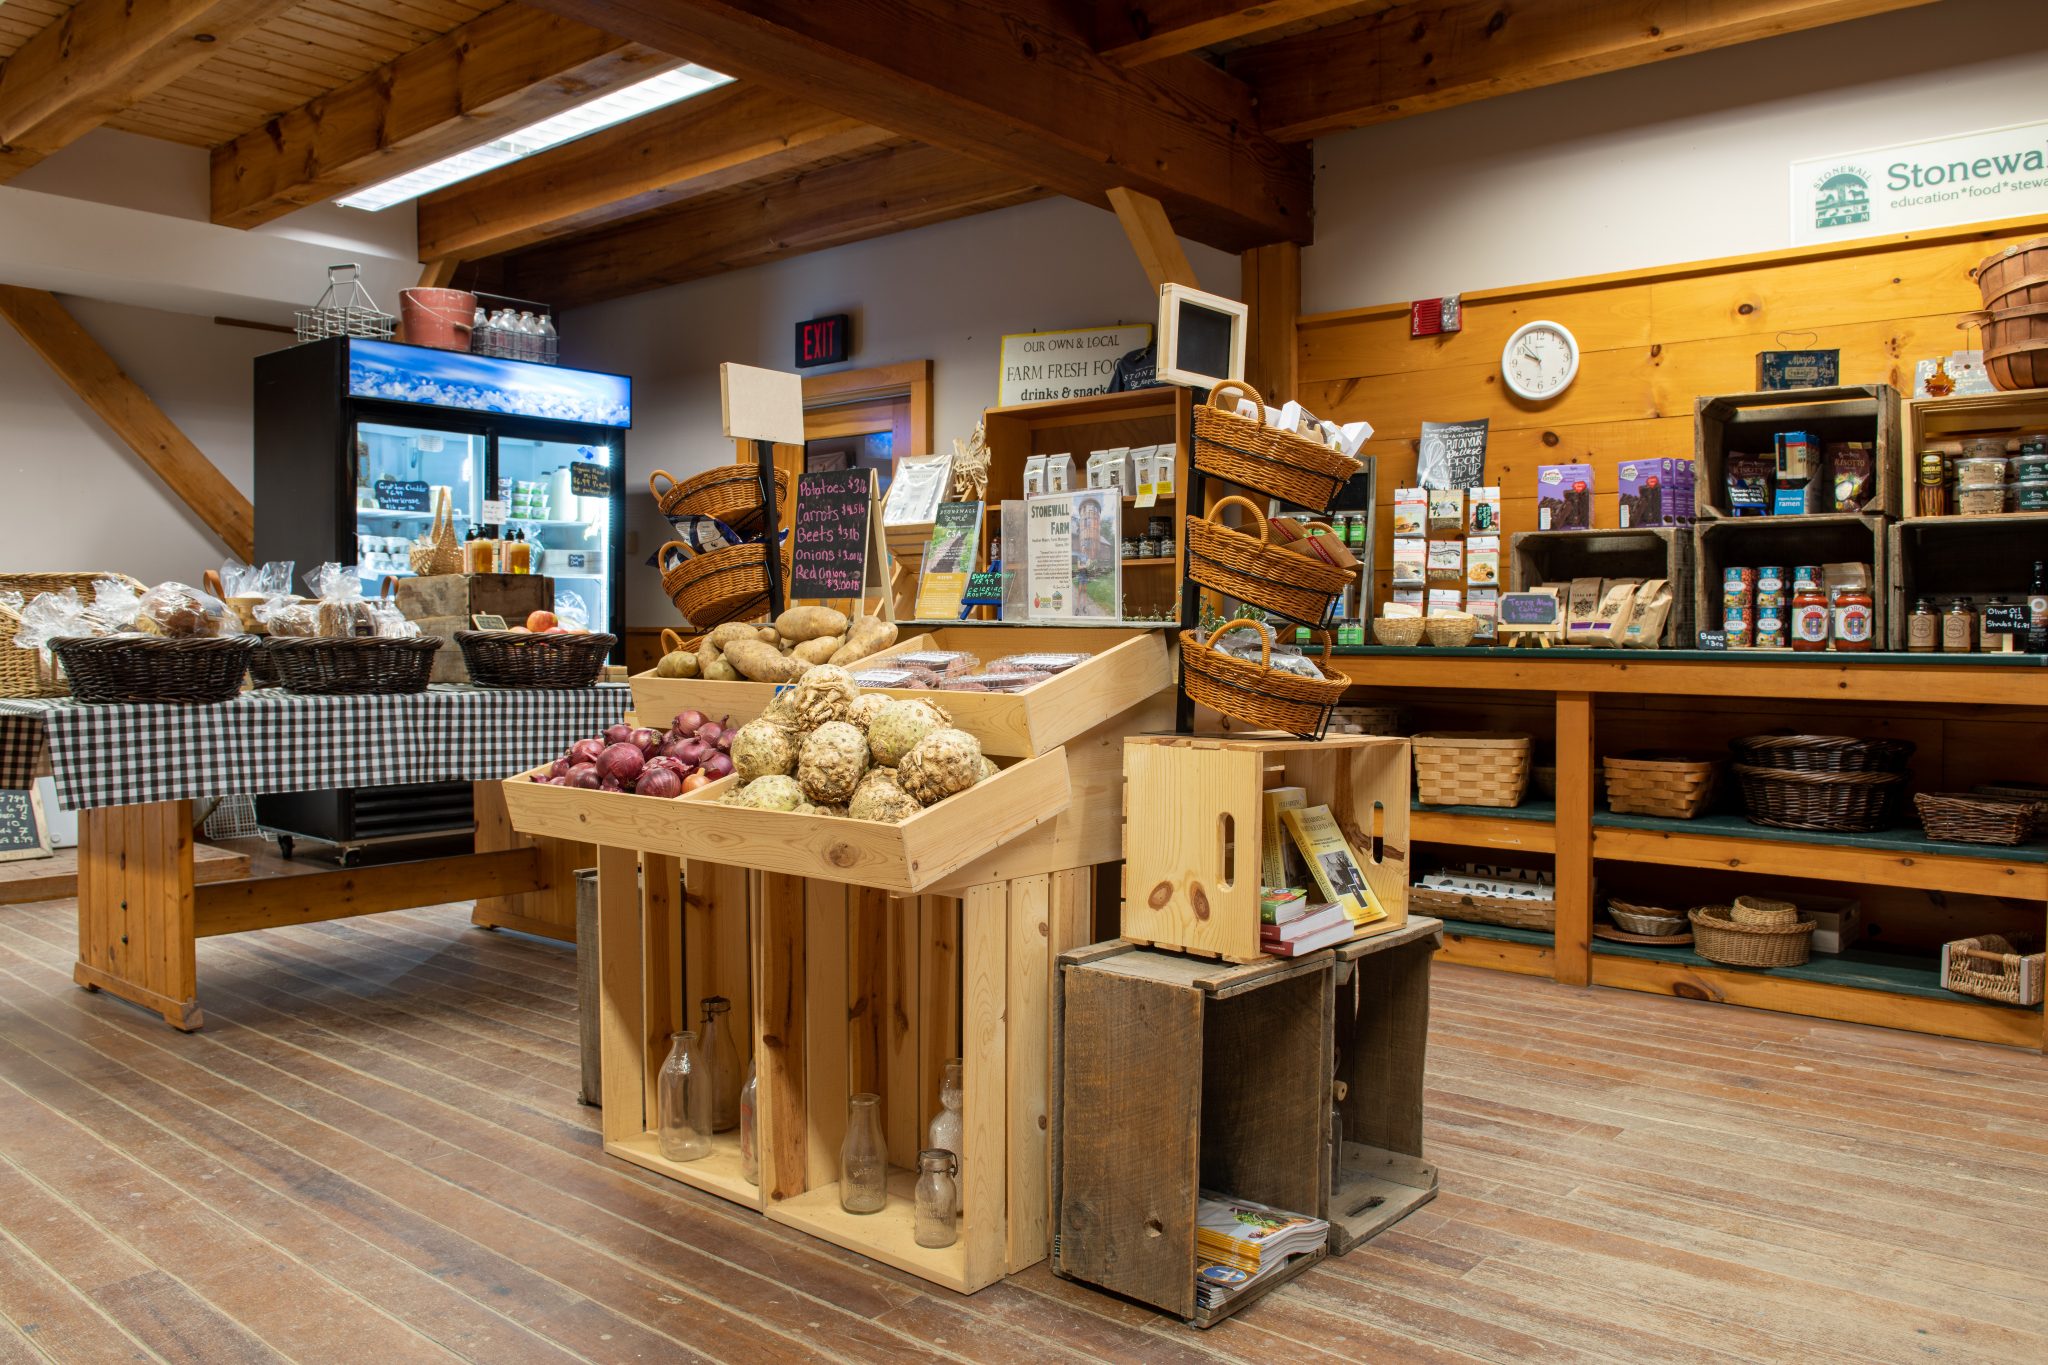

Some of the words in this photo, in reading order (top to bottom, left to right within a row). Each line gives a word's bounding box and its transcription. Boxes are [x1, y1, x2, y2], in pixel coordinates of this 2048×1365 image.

[1813, 165, 1872, 189] STONEWALL
[1887, 149, 2047, 191] Stonewa
[1817, 213, 1868, 227] FARM
[803, 320, 835, 361] EXIT
[1023, 341, 1045, 352] OUR
[1048, 339, 1075, 351] OWN
[1076, 338, 1084, 348] &
[1087, 334, 1120, 348] LOCAL
[1007, 365, 1042, 381] FARM
[1048, 361, 1088, 379] FRESH
[1093, 357, 1122, 375] FOO
[1020, 387, 1059, 401] drinks
[1061, 387, 1071, 398] &
[1073, 384, 1107, 398] snack
[1439, 455, 1481, 467] APRON
[800, 479, 846, 497] Potatoes
[797, 503, 840, 525] Carrots
[1031, 503, 1070, 519] STONEWALL
[796, 524, 834, 543] Beets
[946, 529, 962, 538] CSA
[1051, 521, 1070, 535] FARM
[795, 549, 835, 562] Onions
[795, 564, 817, 580] Red
[818, 566, 847, 580] Onions
[1700, 632, 1725, 641] Beans
